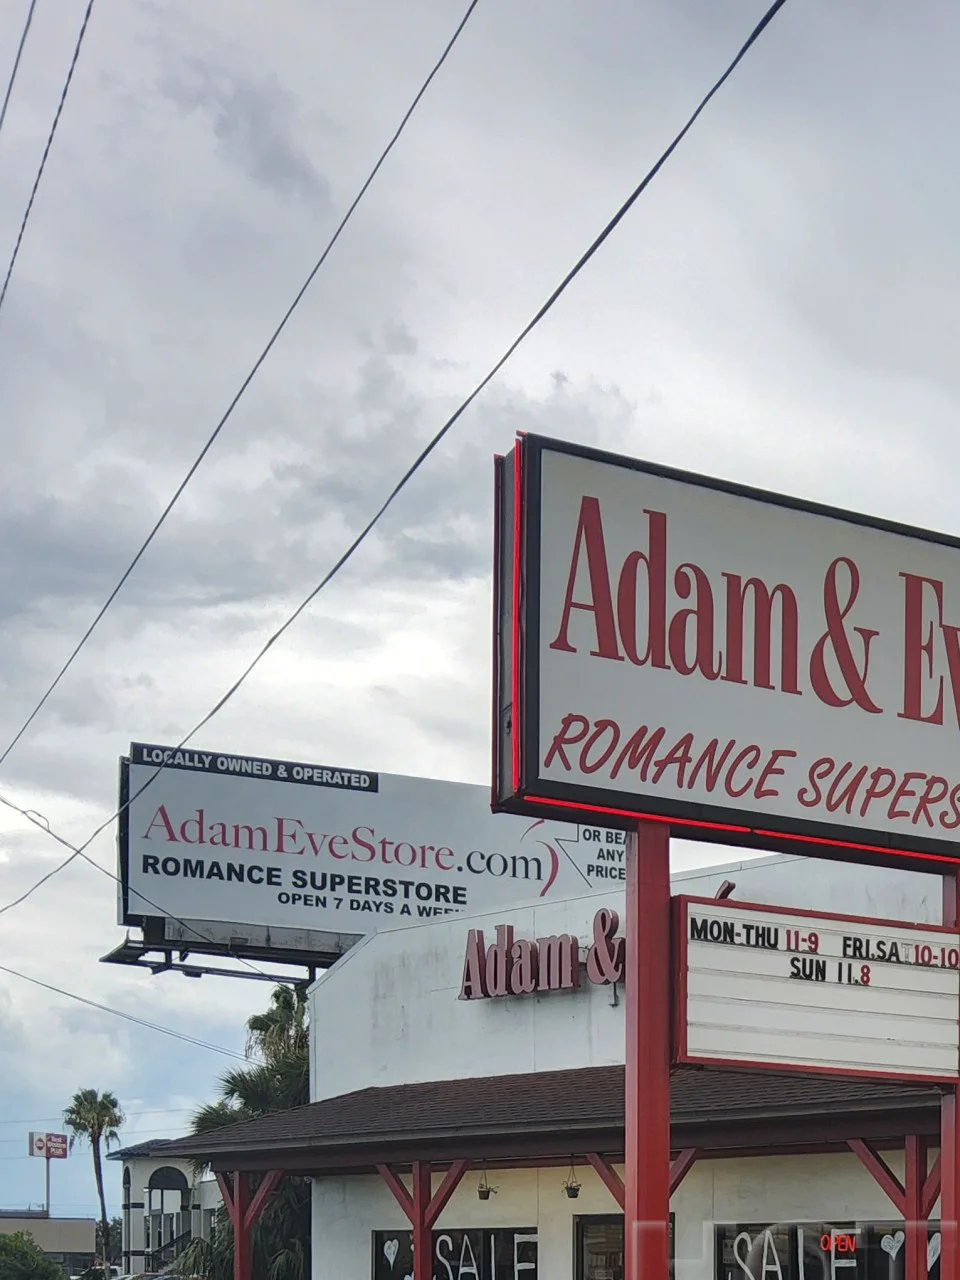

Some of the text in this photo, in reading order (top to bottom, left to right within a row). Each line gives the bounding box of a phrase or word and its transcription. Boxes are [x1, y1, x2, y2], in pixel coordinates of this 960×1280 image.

[549, 496, 802, 696] Adam
[809, 556, 883, 714] &
[143, 748, 370, 788] LOCALLY OWNED & OPERATED
[544, 713, 797, 799] ROMANCE
[141, 804, 544, 881] AdamEveStore.com
[582, 828, 601, 844] OR
[586, 865, 626, 881] PRICE
[596, 848, 625, 862] ANY
[142, 854, 467, 905] ROMANCE SUPERSTORE
[277, 892, 466, 918] OPEN 7 DAYS A WE
[690, 917, 779, 949] MON-THU
[786, 929, 819, 953] 11-9
[458, 908, 626, 1001] Adam &
[790, 957, 826, 982] SUN
[820, 1234, 857, 1252] OPEN
